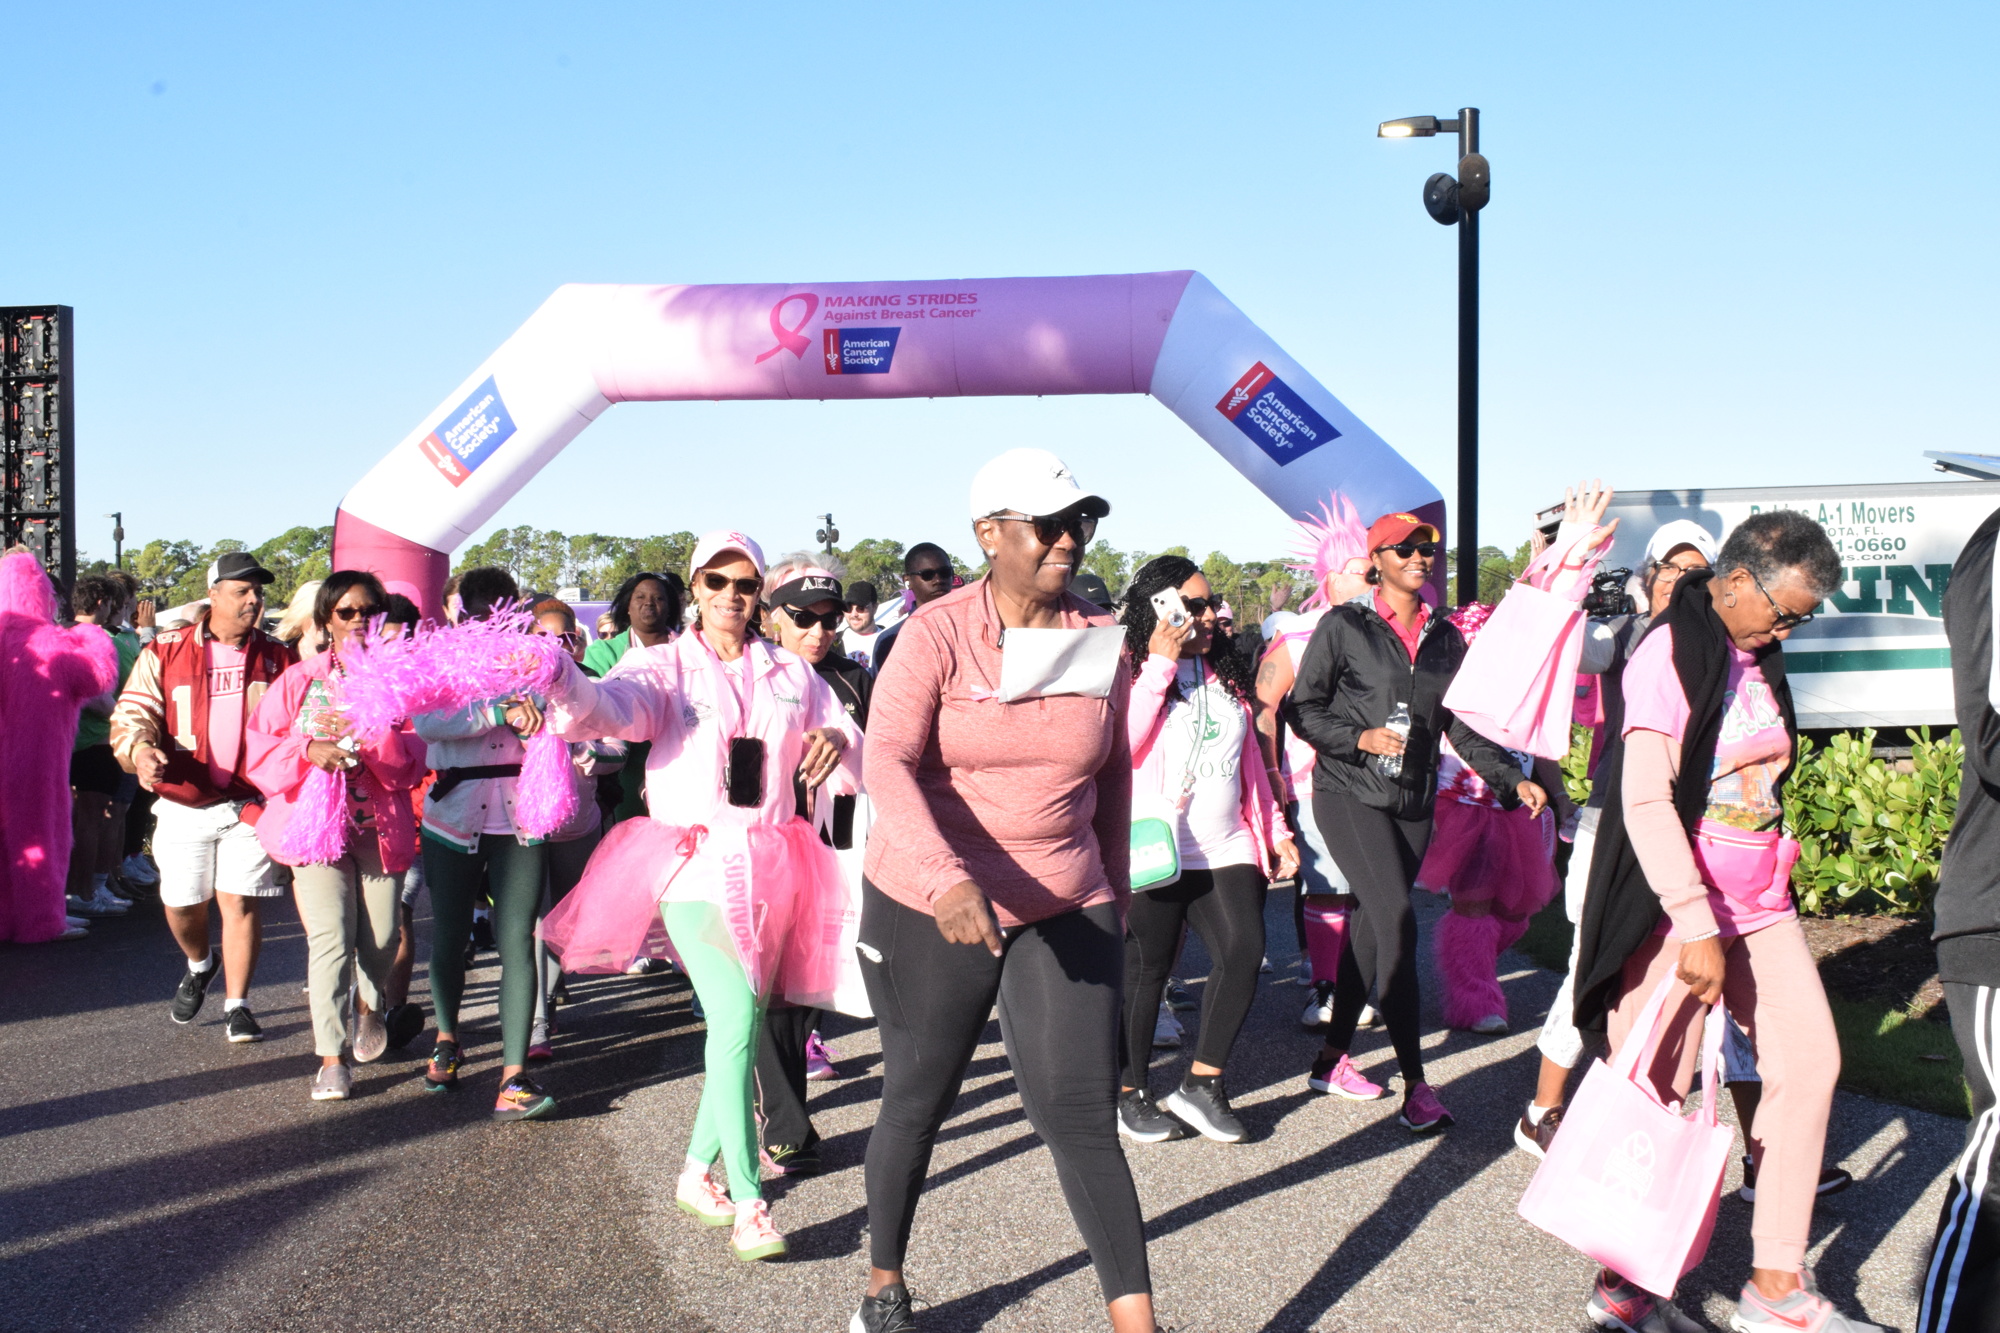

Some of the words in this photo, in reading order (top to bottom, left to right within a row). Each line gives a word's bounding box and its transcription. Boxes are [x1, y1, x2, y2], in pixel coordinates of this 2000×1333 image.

[824, 294, 901, 307] MAKING
[906, 293, 978, 306] STRIDES
[823, 309, 877, 323] Against
[881, 308, 925, 320] Breast
[843, 339, 890, 348] American
[843, 348, 877, 357] Cancer
[444, 394, 495, 443] American
[1255, 399, 1296, 435] Cancer
[1263, 391, 1317, 441] American
[450, 414, 488, 450] Cancer
[1817, 502, 1843, 525] A-1
[1851, 501, 1916, 524] Movers
[1826, 527, 1859, 537] OTA,
[1864, 526, 1884, 536] FL.
[1834, 537, 1907, 553] 1-0660
[801, 577, 838, 593] AKA
[216, 671, 232, 692] IN
